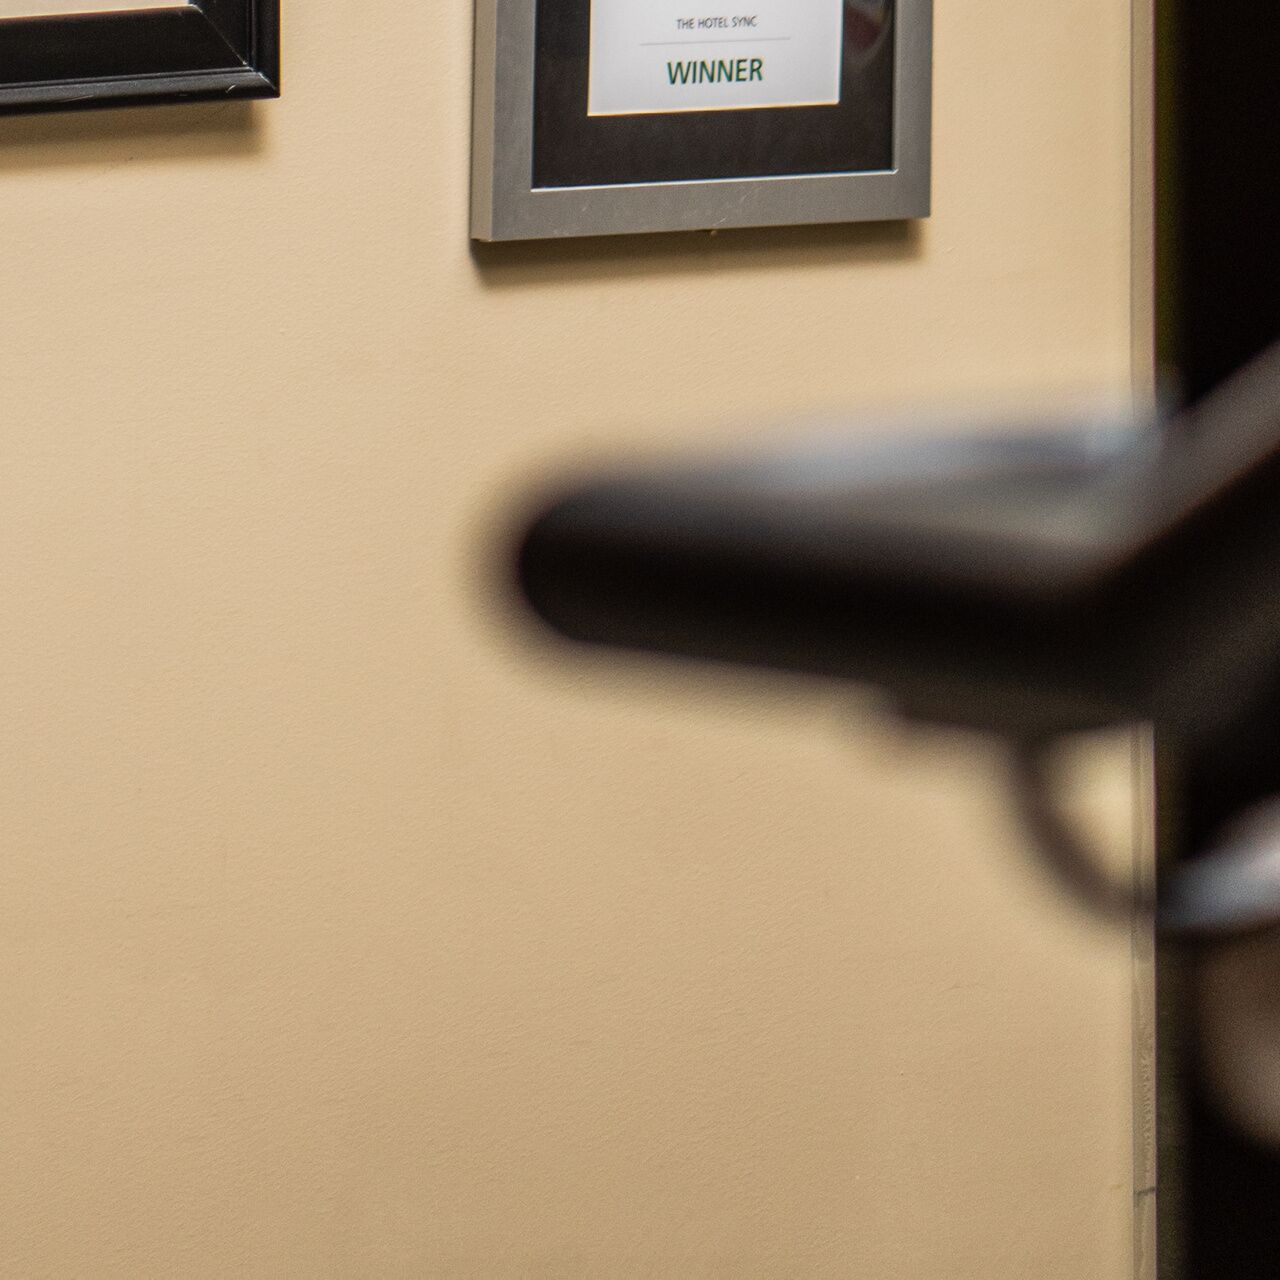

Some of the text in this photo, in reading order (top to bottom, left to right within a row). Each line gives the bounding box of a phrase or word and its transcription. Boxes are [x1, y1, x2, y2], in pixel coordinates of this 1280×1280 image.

[677, 15, 758, 30] THE HOTEL SYNC
[667, 59, 763, 84] WINNER
